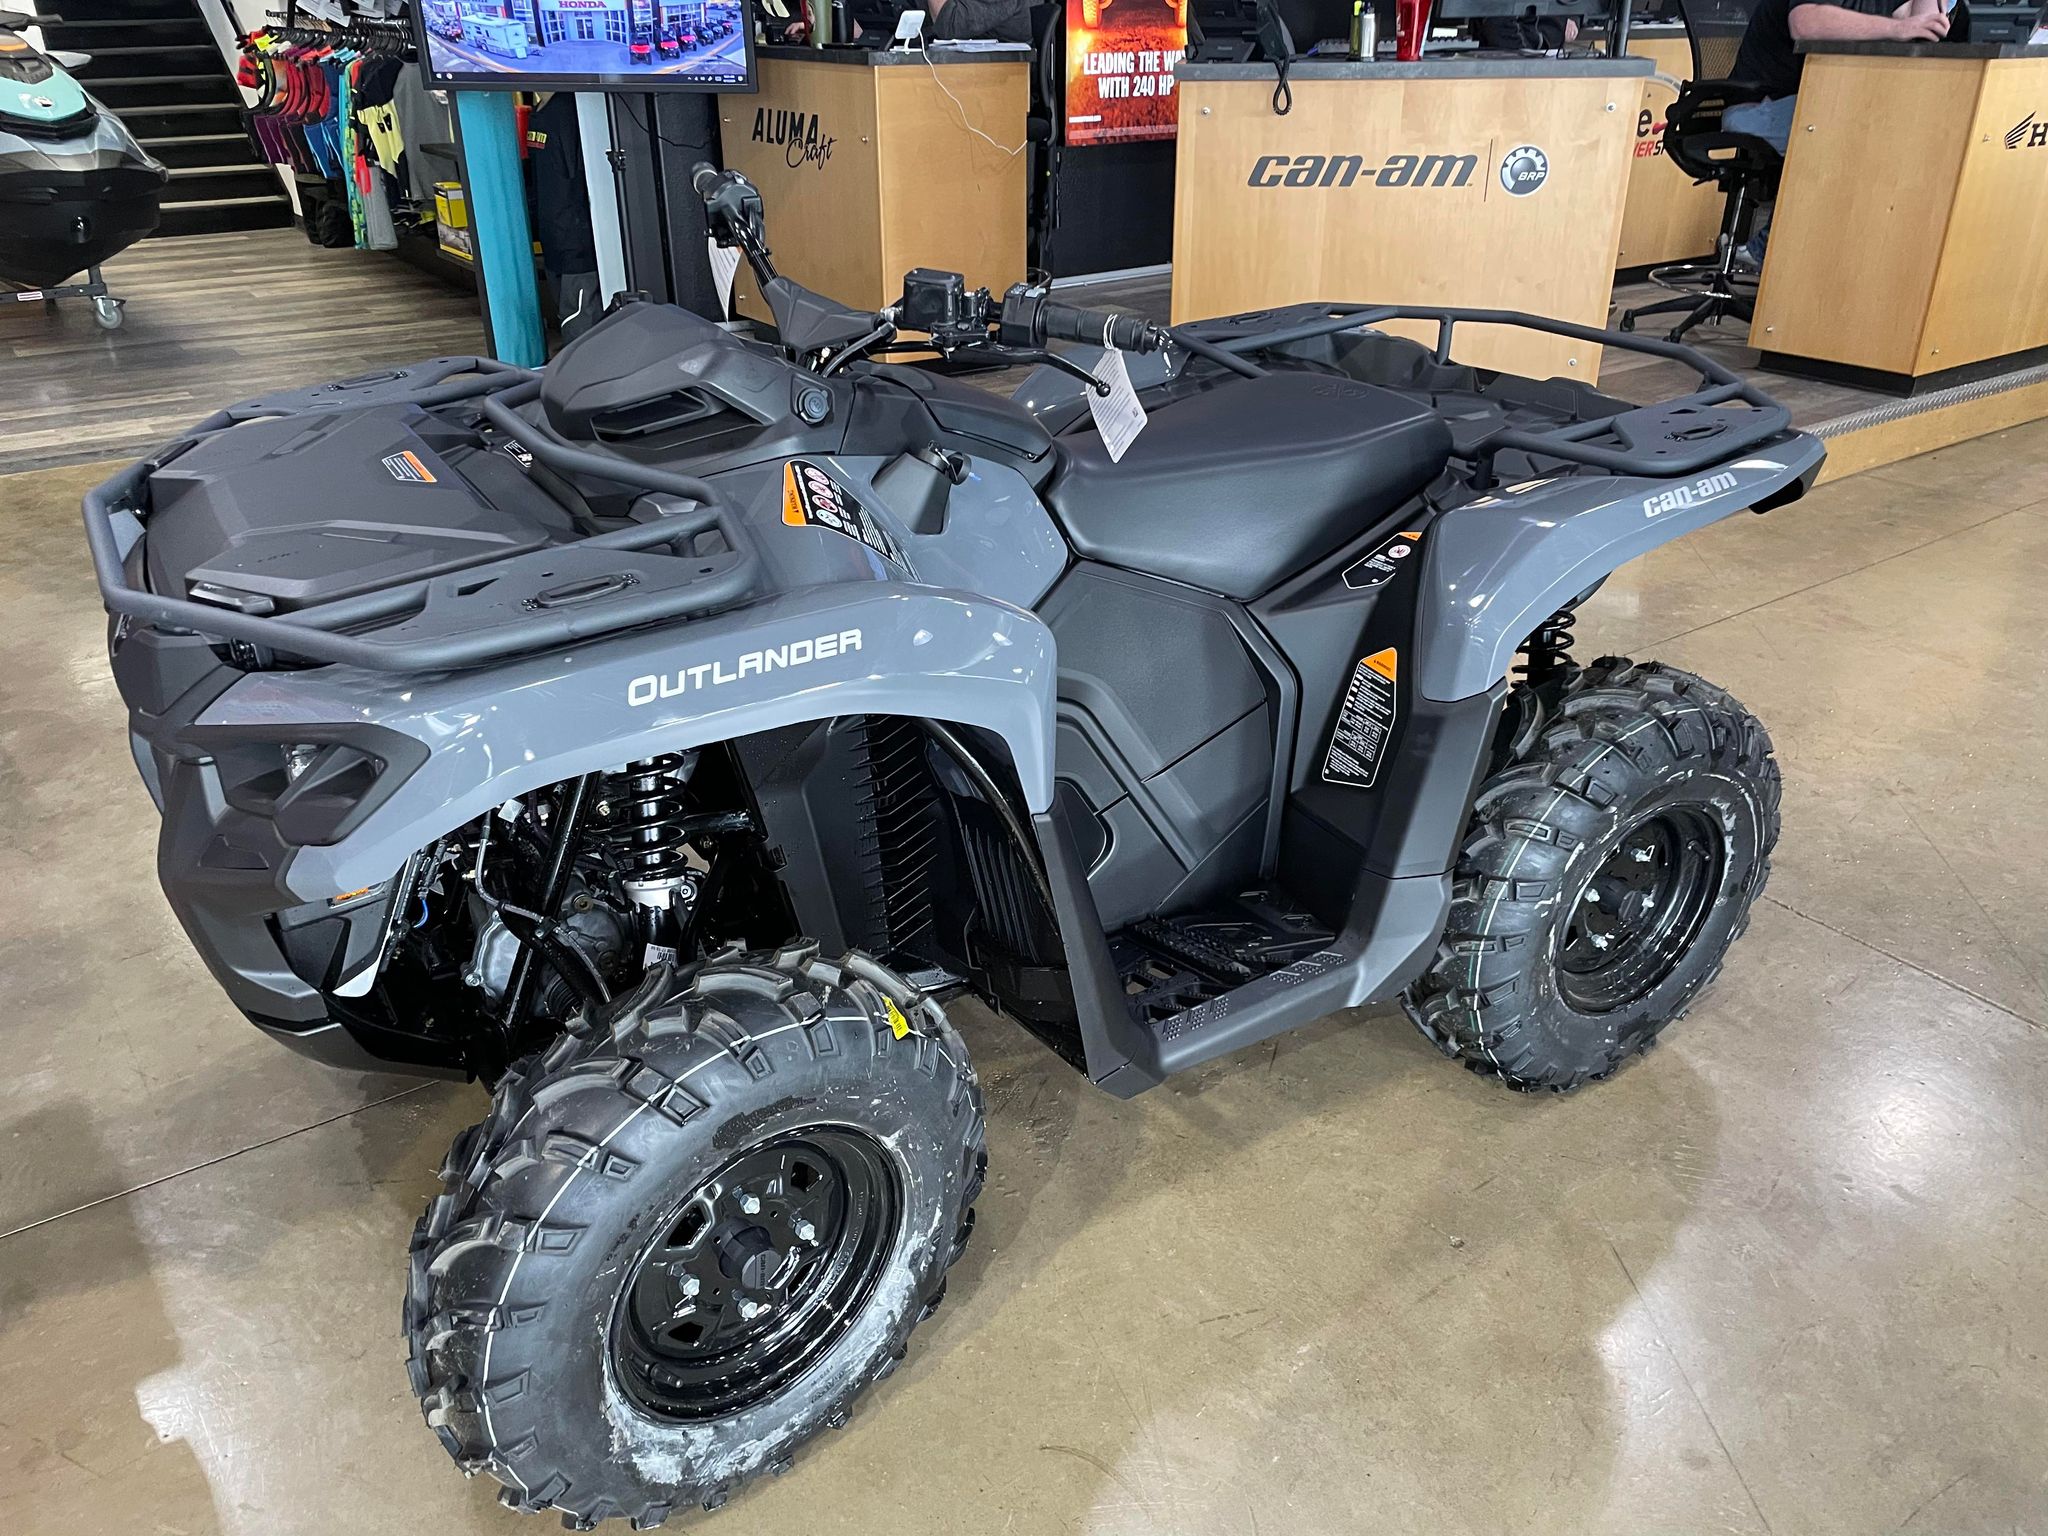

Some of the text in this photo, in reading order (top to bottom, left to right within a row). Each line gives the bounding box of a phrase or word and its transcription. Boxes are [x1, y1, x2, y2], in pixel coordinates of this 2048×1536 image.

[558, 0, 608, 9] HONDA
[1083, 50, 1186, 75] LEADING THE WA
[1098, 74, 1175, 99] WITH 240 HP
[752, 107, 819, 147] ALUMA
[786, 133, 837, 170] Craft
[1247, 155, 1479, 187] can-am
[1518, 171, 1546, 181] BRP
[1643, 471, 1738, 518] can-am
[628, 628, 863, 707] OUTLANDER
